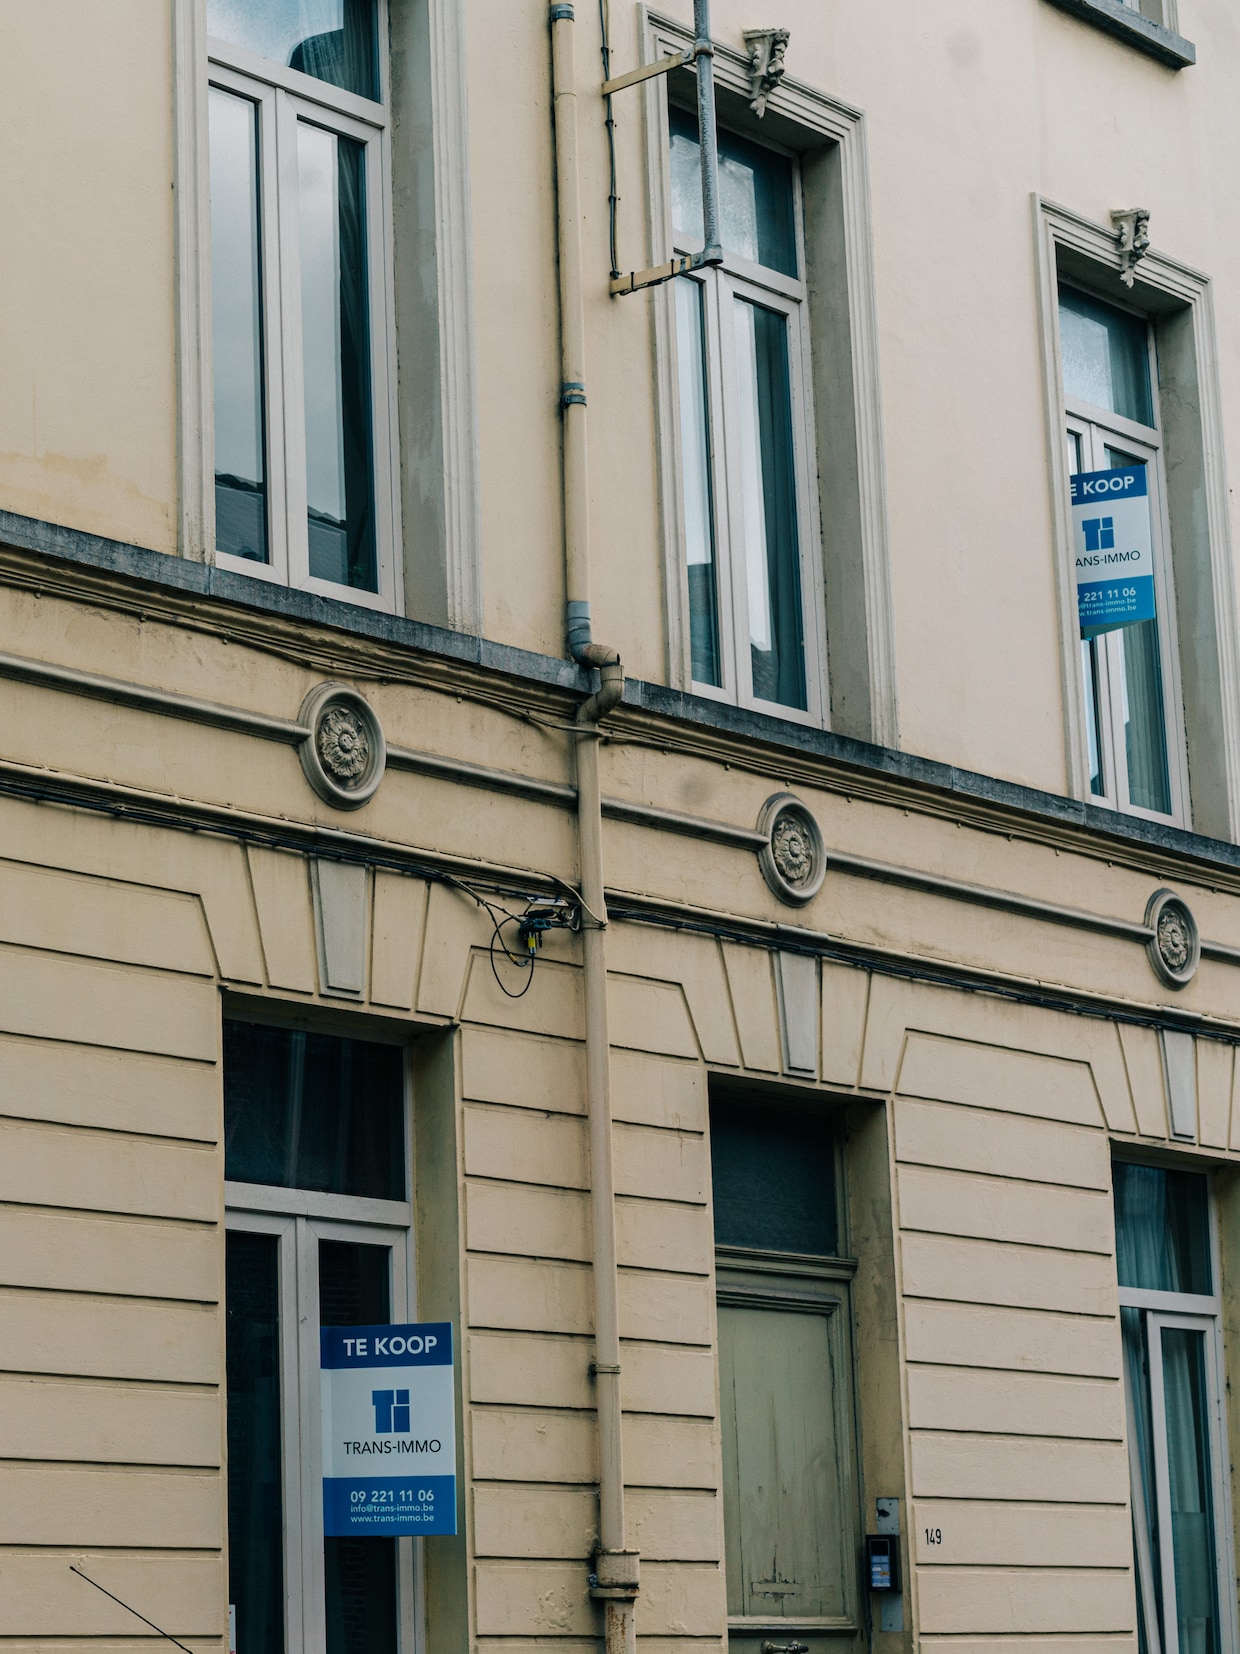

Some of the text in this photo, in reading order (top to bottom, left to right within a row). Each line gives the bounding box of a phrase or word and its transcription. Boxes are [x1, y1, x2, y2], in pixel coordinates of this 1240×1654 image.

[1083, 475, 1135, 495] KOOP
[1084, 591, 1103, 602] 221
[1107, 589, 1119, 599] 11
[1122, 587, 1137, 597] 06
[1078, 597, 1137, 610] @trans-immo.be
[342, 1335, 438, 1357] TE KOOP
[343, 1439, 442, 1455] TRANS-IMMO
[350, 1489, 435, 1503] 09 221 11 06
[350, 1503, 435, 1513] info@trans-immo.be
[350, 1513, 435, 1523] www.trans-immo.be
[925, 1528, 942, 1545] 149
